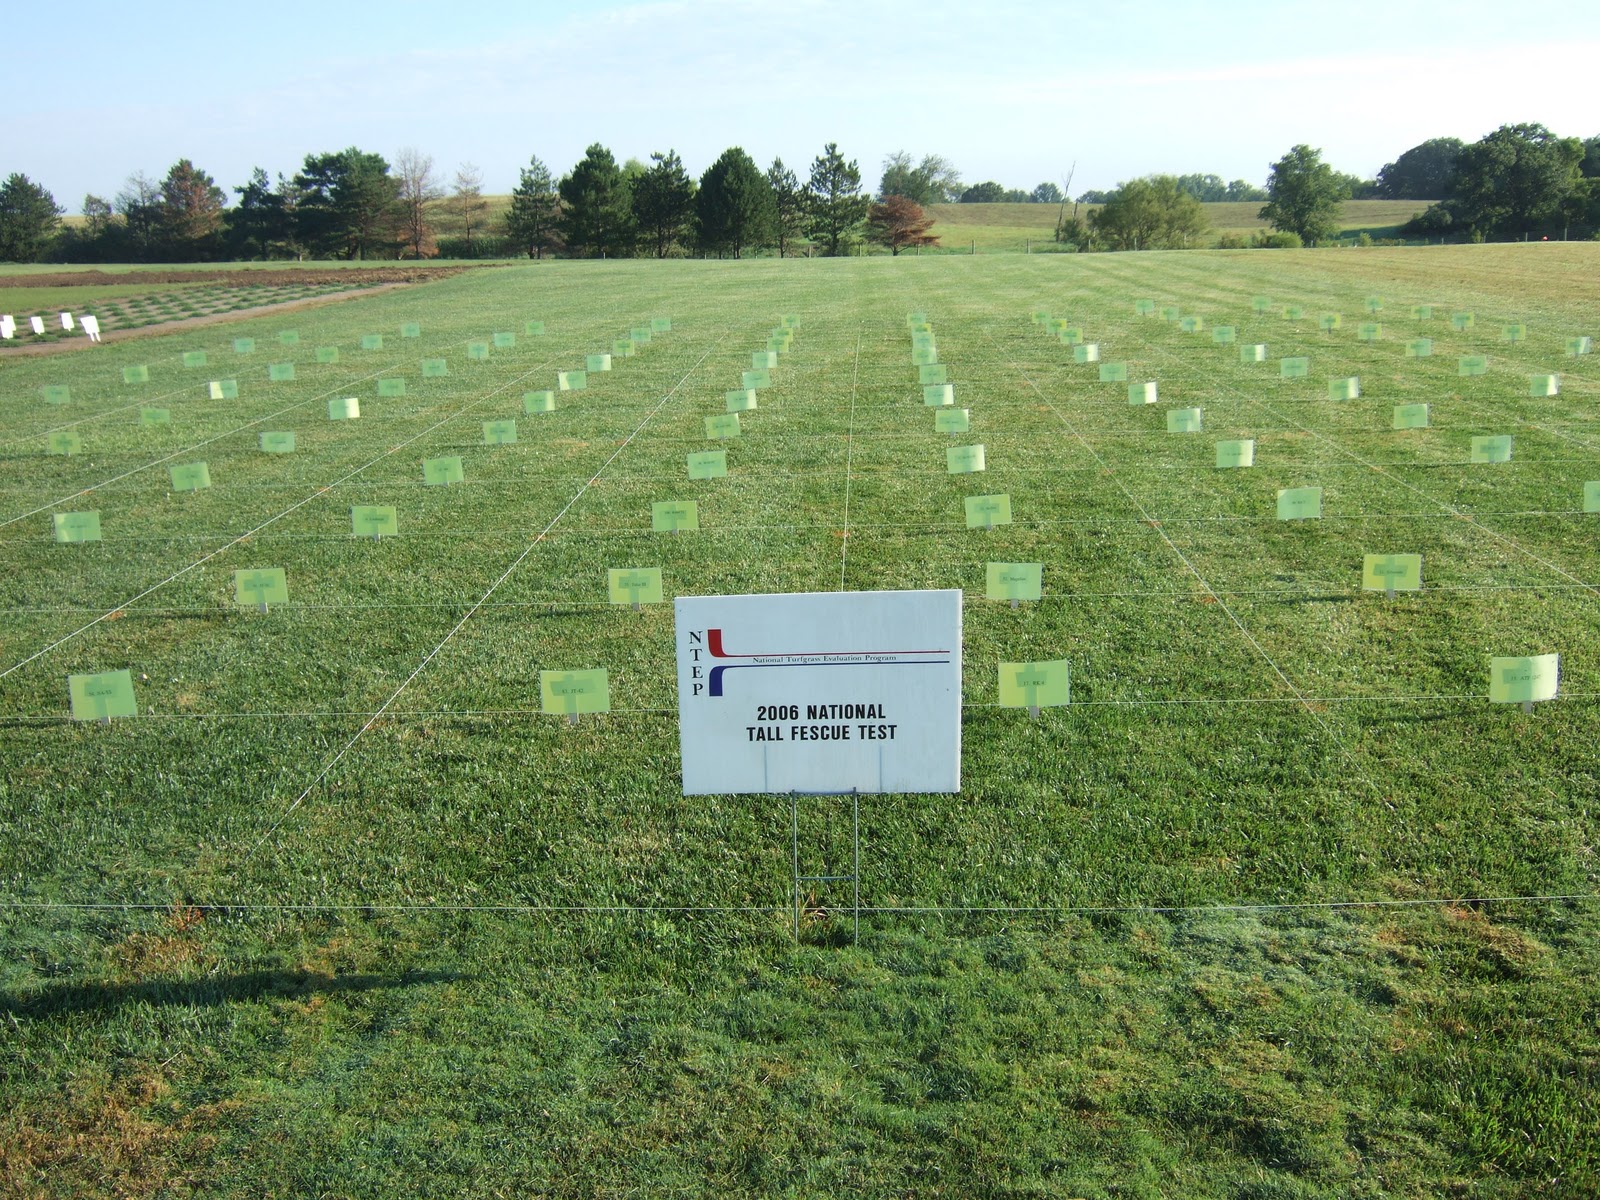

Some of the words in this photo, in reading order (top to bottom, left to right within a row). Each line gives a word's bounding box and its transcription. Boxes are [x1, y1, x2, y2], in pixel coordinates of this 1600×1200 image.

[689, 630, 704, 696] NTEP
[786, 656, 821, 664] Turfgrass
[865, 655, 897, 663] Program
[757, 705, 799, 721] 2006
[807, 704, 886, 720] NATIONAL
[746, 726, 784, 742] TALL
[791, 725, 850, 741] FESCUE
[858, 724, 898, 740] TEST
